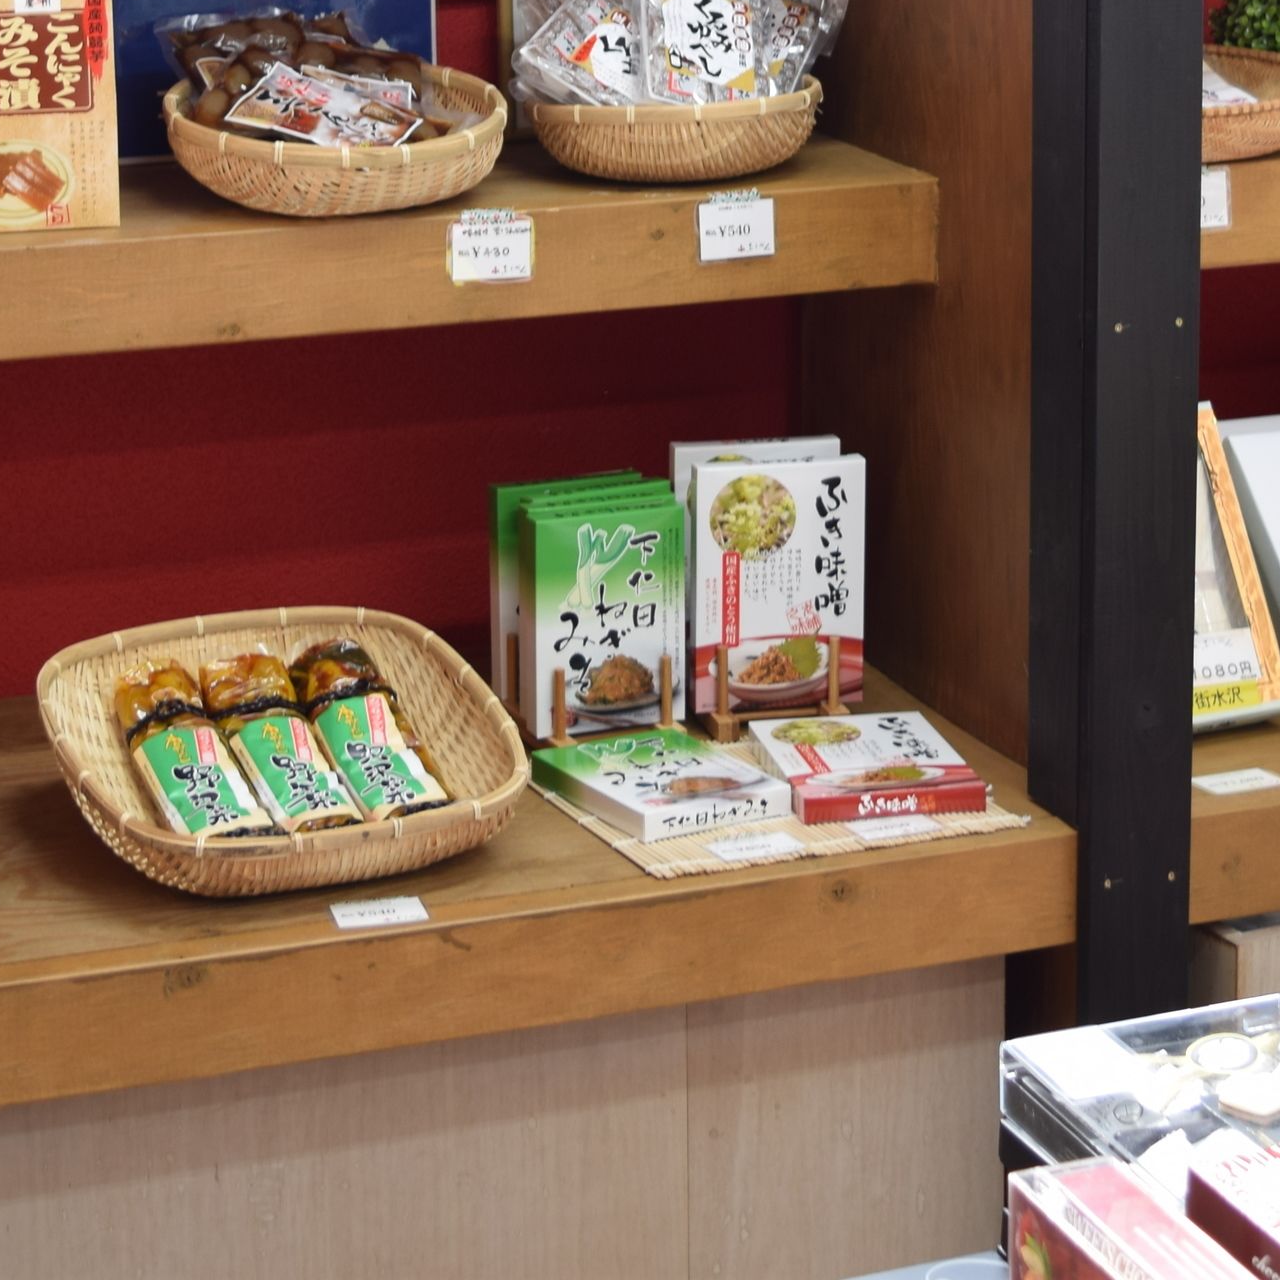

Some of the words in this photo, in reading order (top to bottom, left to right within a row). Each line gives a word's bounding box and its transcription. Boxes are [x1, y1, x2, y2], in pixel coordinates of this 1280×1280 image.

[719, 224, 751, 238] ¥540
[629, 532, 660, 628] 下仁田
[815, 476, 850, 617] ふき味噌
[594, 583, 632, 652] ねぎ
[1195, 686, 1244, 709] 街水沢
